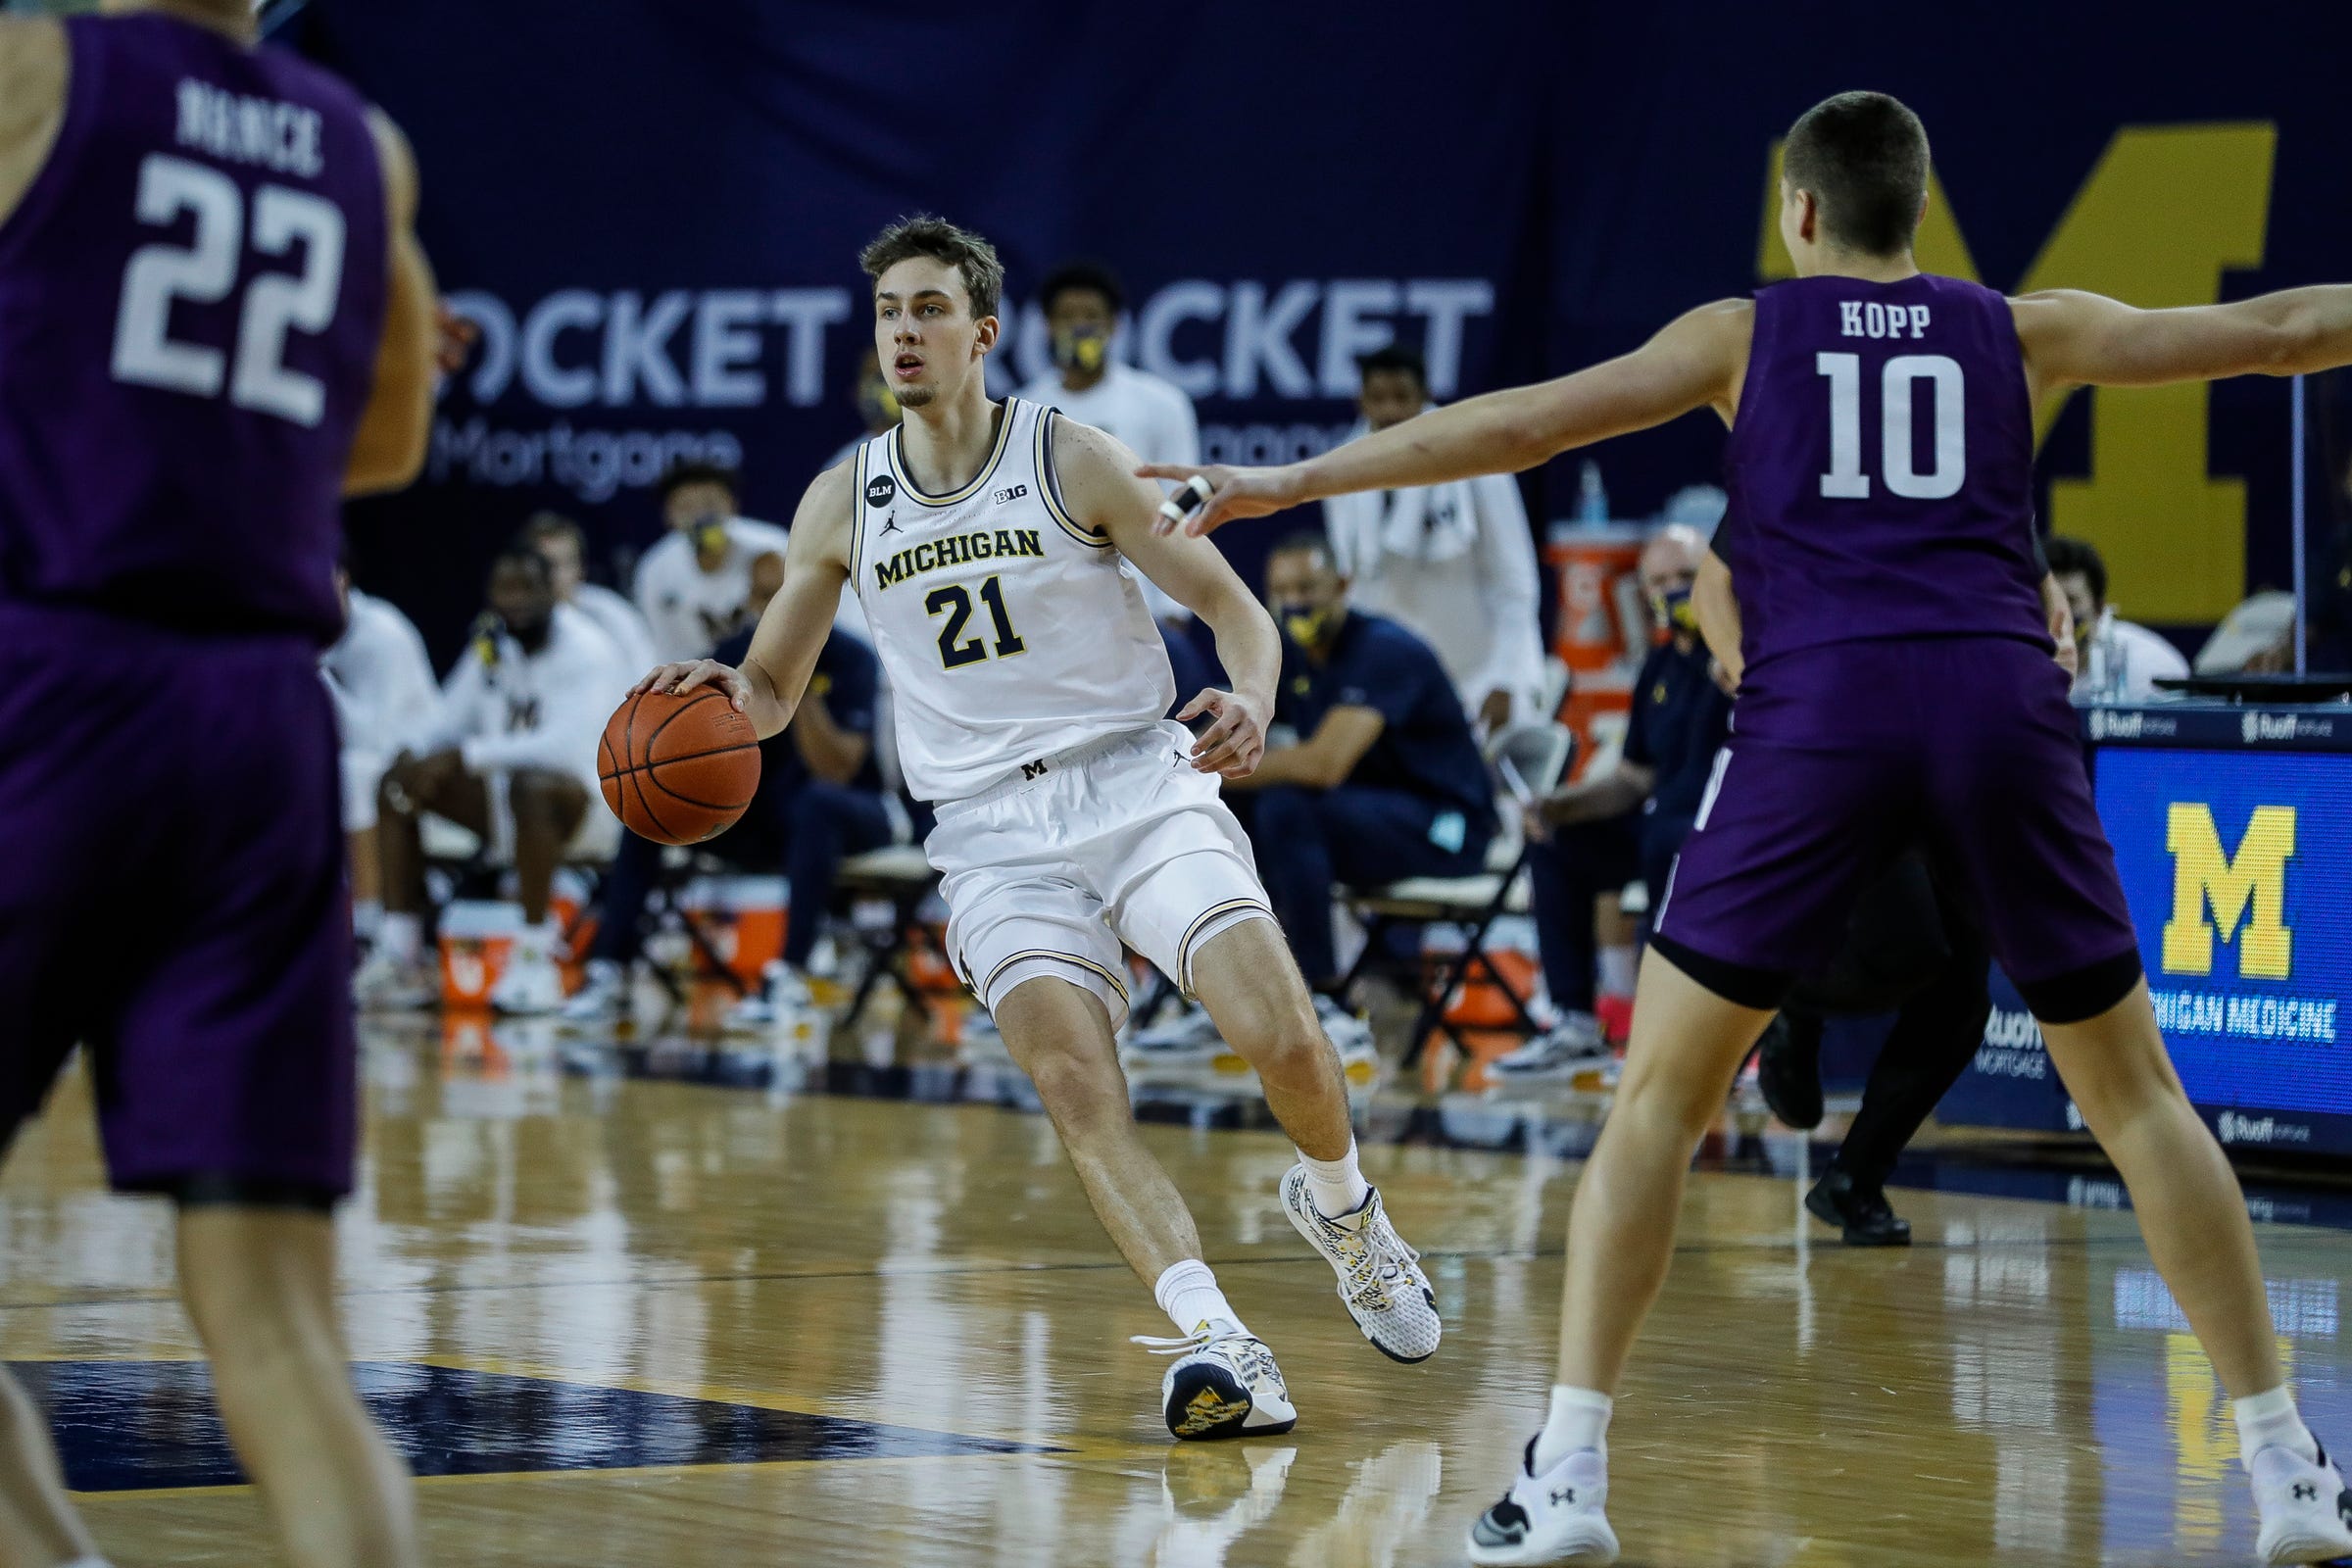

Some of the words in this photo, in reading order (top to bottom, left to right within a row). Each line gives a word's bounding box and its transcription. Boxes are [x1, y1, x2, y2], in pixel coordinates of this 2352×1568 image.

[110, 153, 347, 428] 22
[1838, 300, 1931, 339] KOPP
[1816, 351, 1966, 499] 10
[868, 483, 893, 498] BLM
[874, 528, 1047, 592] MICHIGAN
[924, 572, 1027, 671] 21
[1020, 758, 1049, 782] M
[2162, 802, 2297, 981] M
[2227, 994, 2337, 1043] MEDICINE
